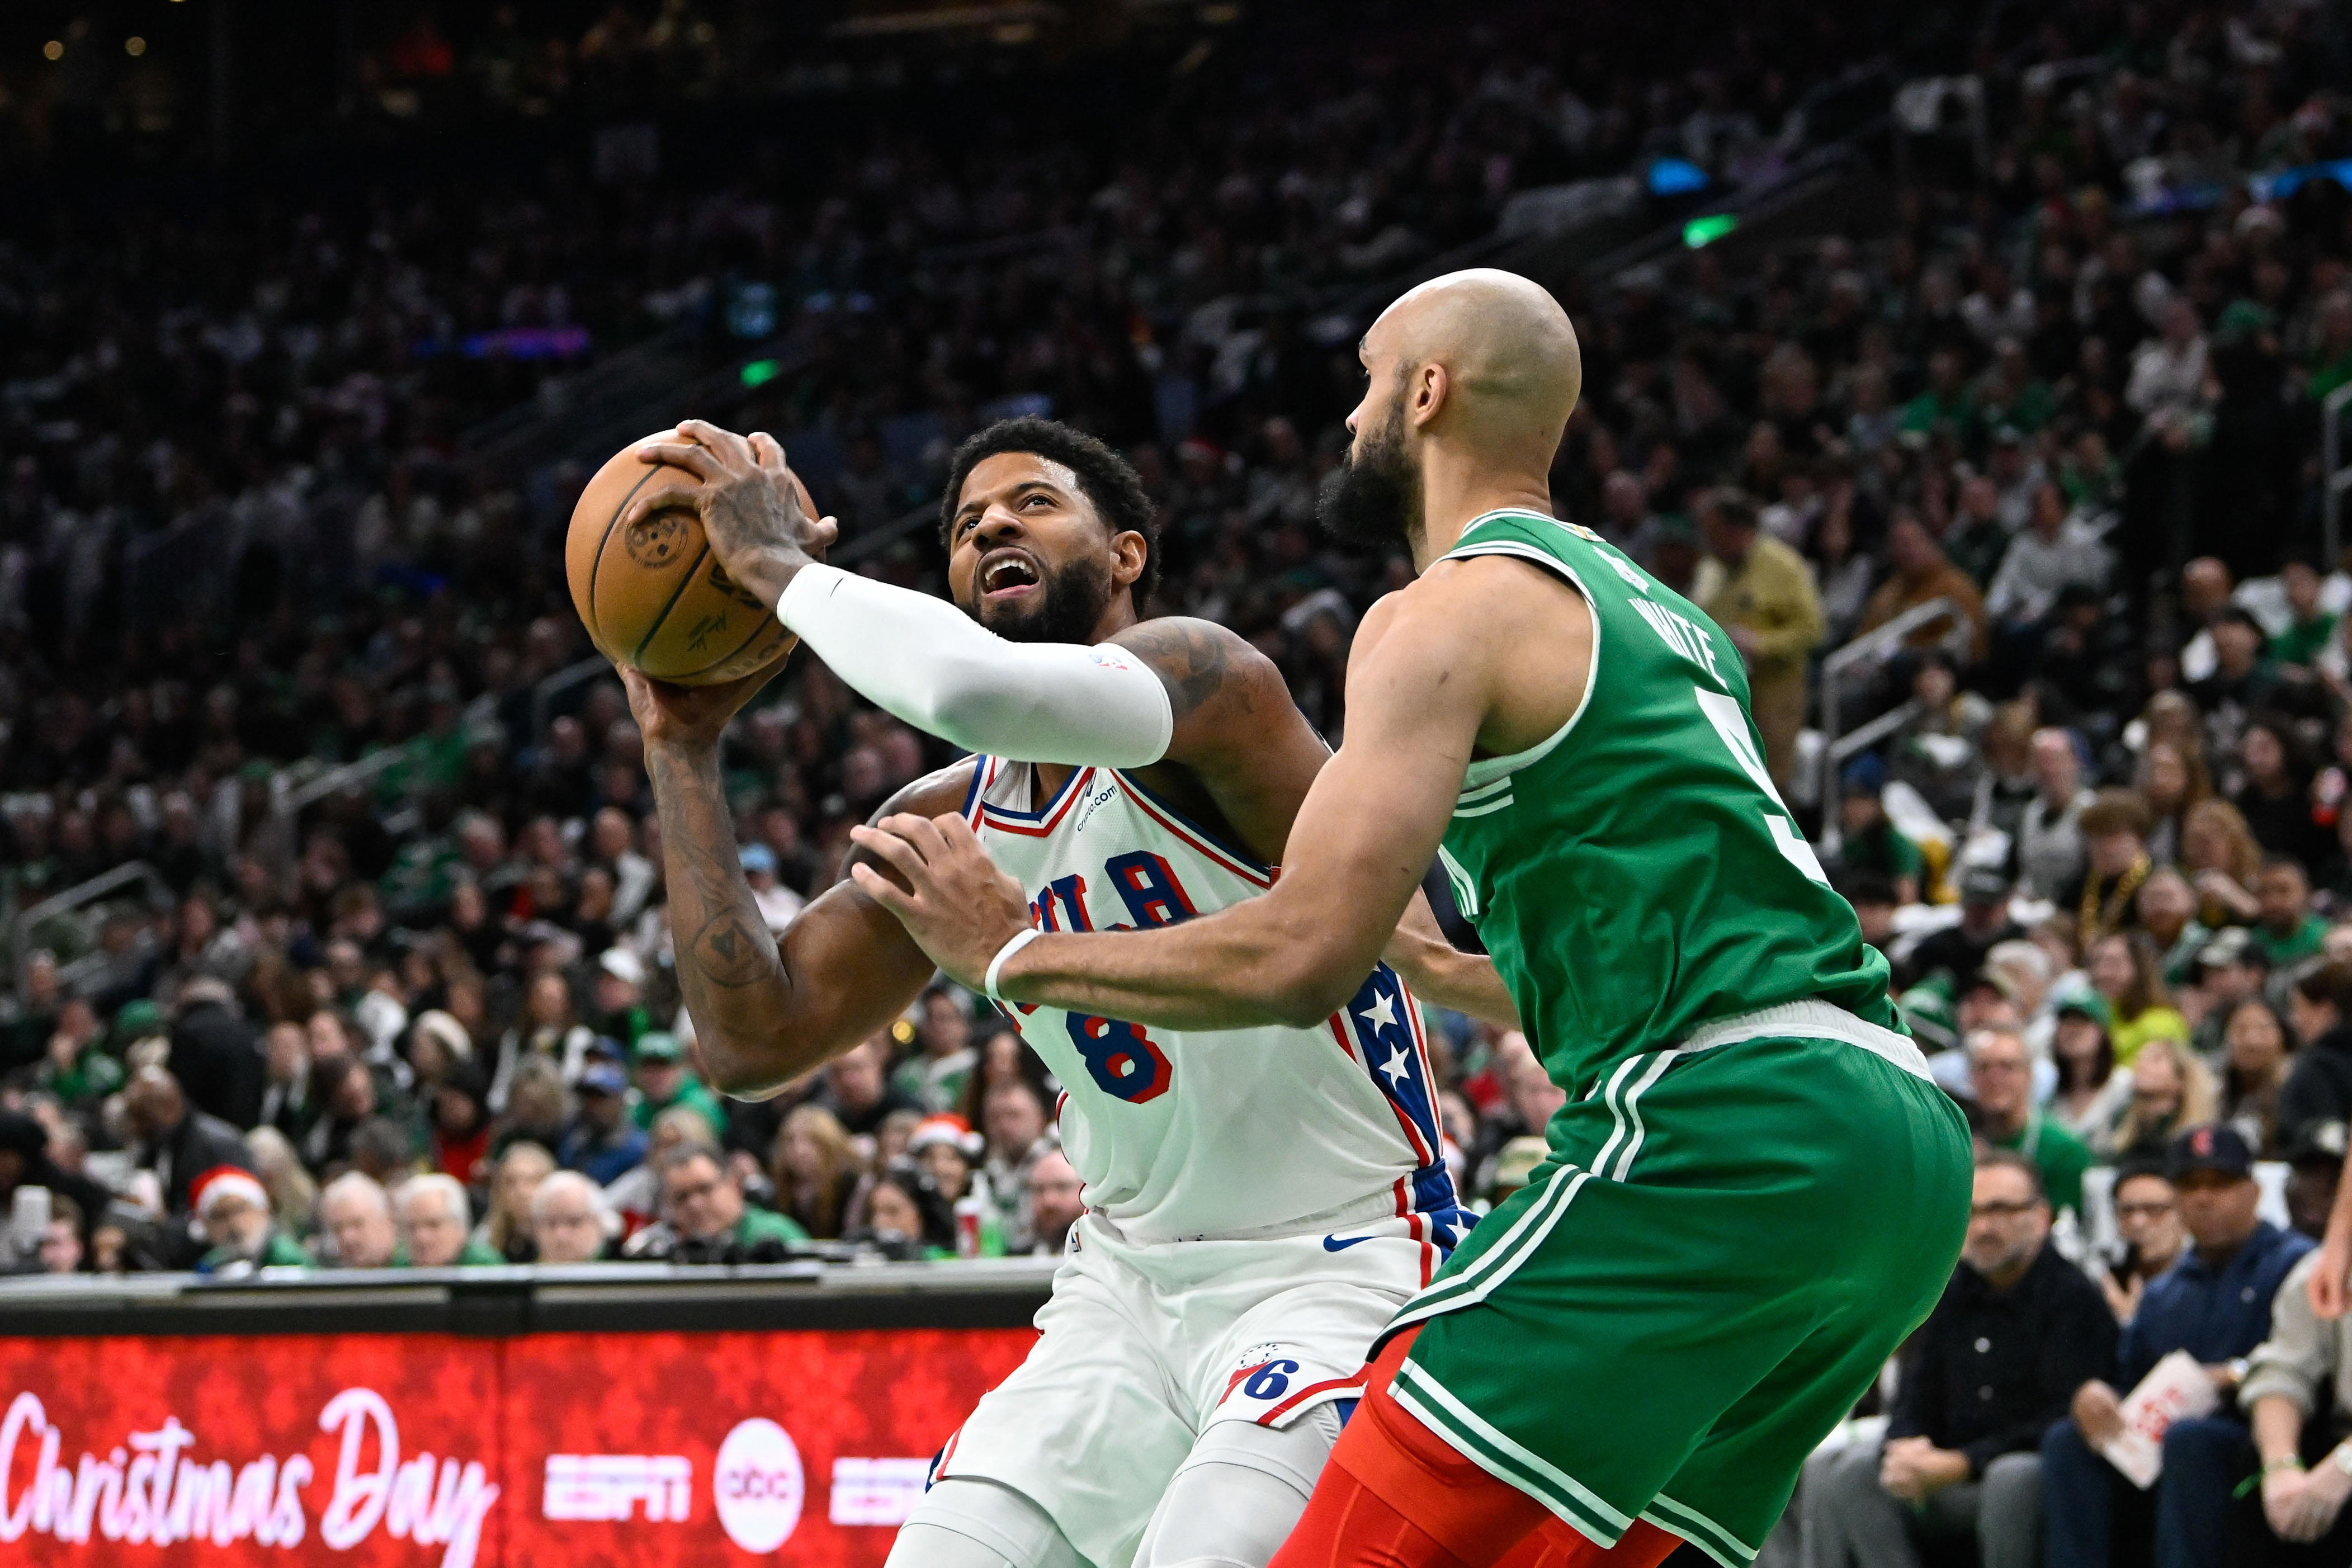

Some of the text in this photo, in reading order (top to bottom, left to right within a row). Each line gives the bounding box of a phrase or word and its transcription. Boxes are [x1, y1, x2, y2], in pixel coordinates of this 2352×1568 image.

[1627, 597, 1730, 692] WHITE
[1077, 785, 1117, 832] crypto.com
[1065, 1010, 1173, 1104] 8
[0, 1387, 499, 1568] Christmas Day
[542, 1455, 693, 1522] ESPN
[725, 1461, 788, 1500] abc
[829, 1457, 933, 1526] ESP
